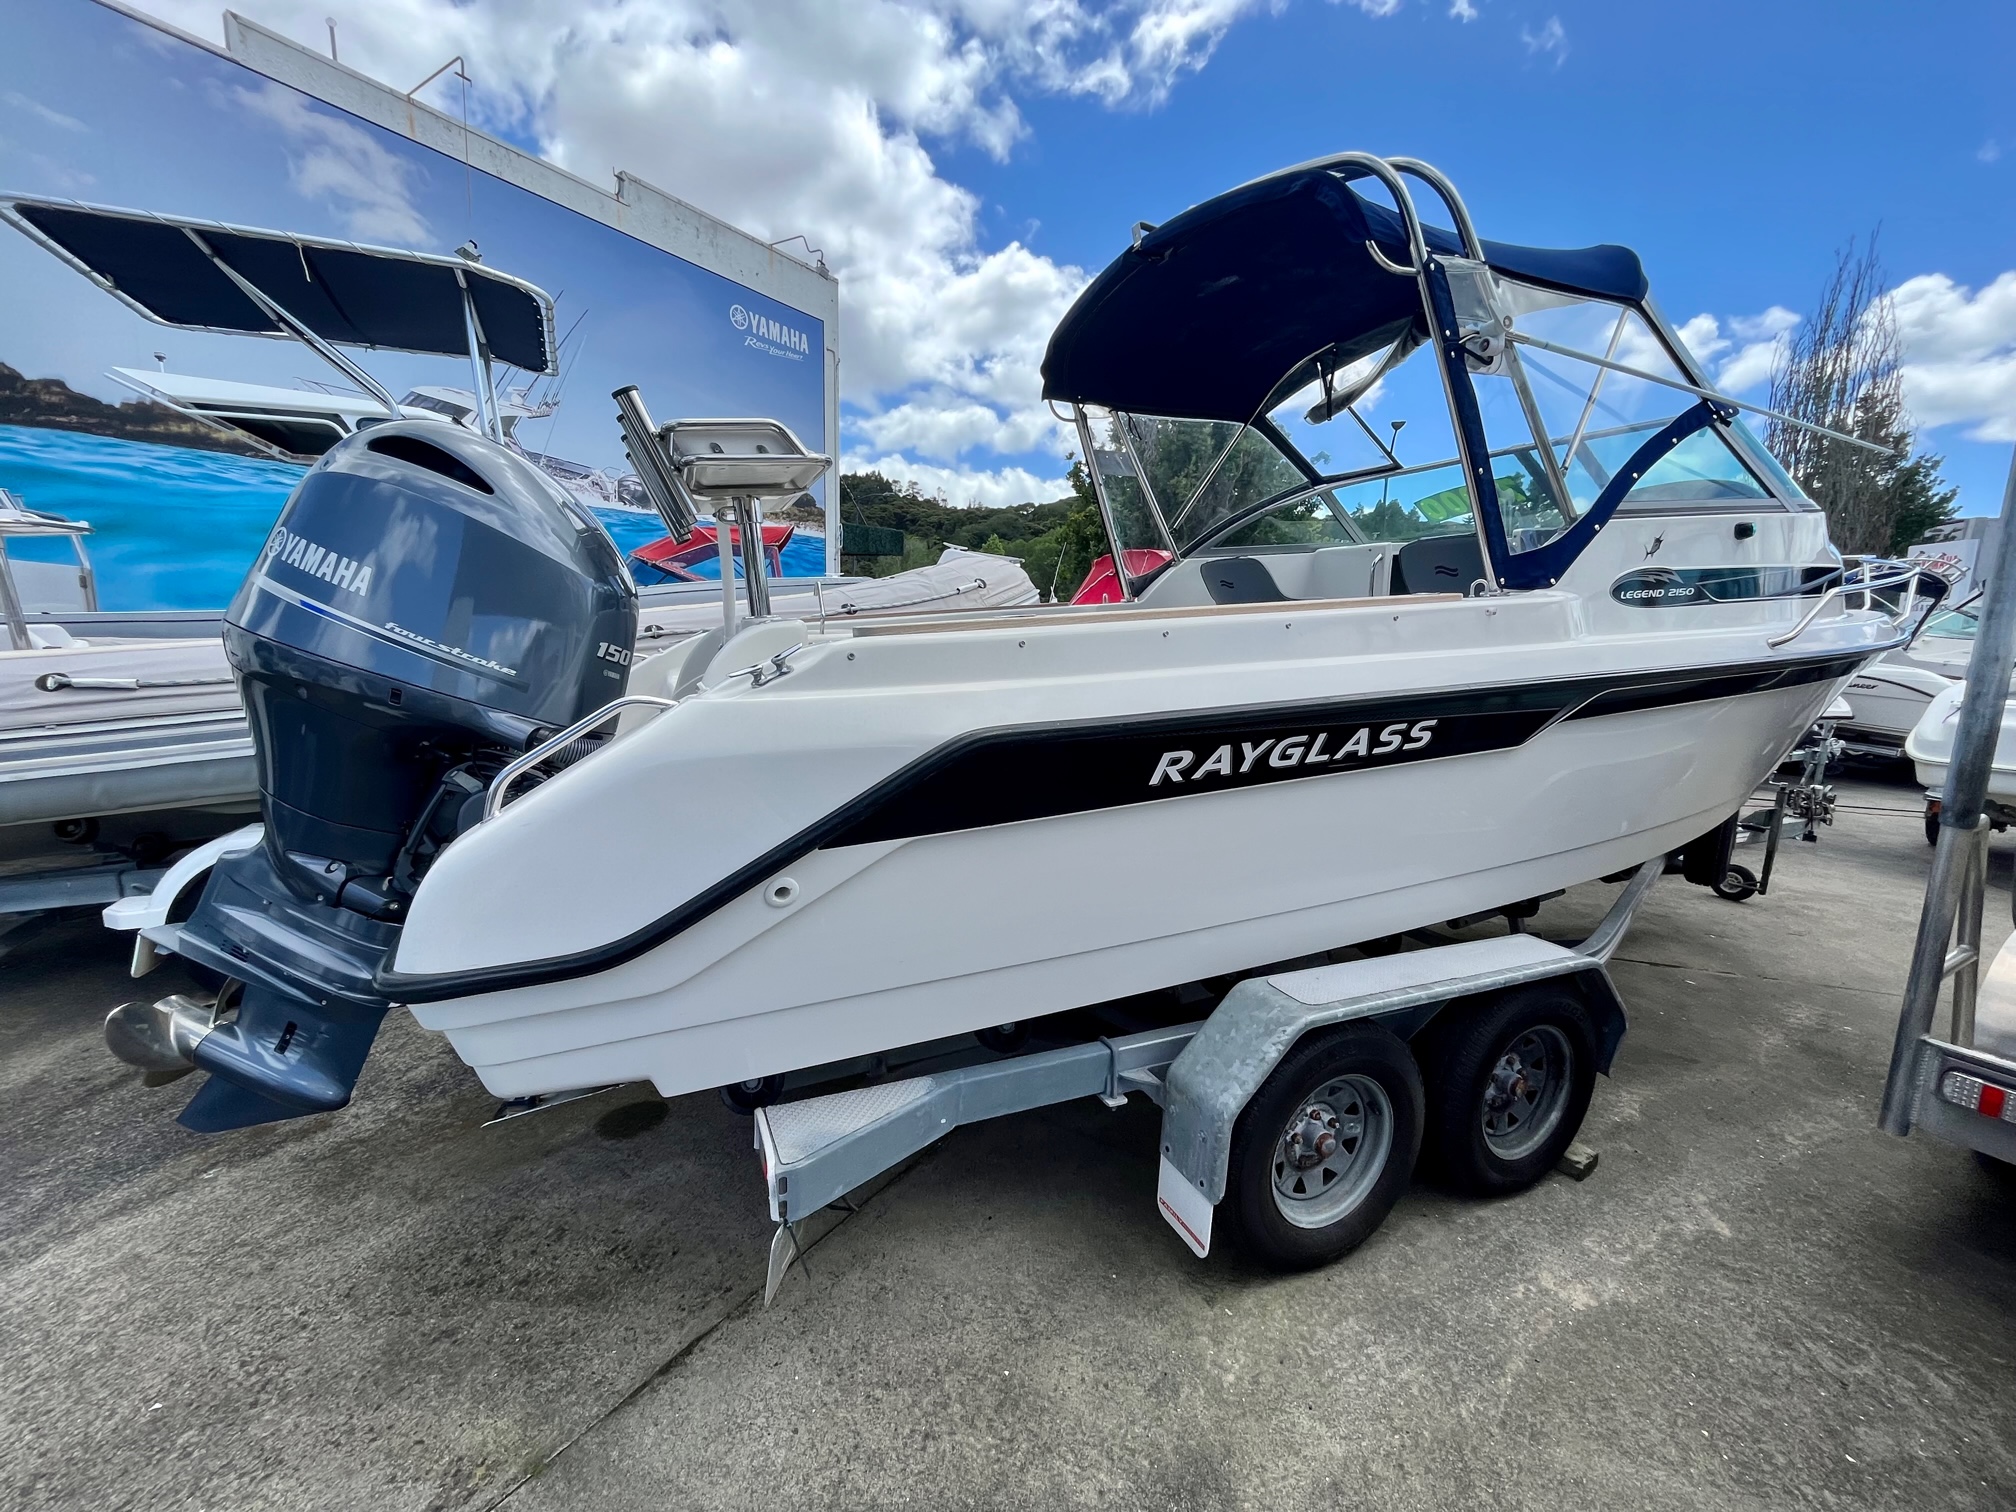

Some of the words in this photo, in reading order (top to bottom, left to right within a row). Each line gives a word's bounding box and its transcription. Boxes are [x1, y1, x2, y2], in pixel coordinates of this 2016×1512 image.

[748, 311, 809, 355] YAMAHA
[280, 532, 373, 597] YAMAHA
[1620, 588, 1665, 600] LEGEND
[1667, 587, 1696, 597] 2150
[596, 641, 631, 666] 150
[1148, 718, 1438, 787] RAYGLASS
